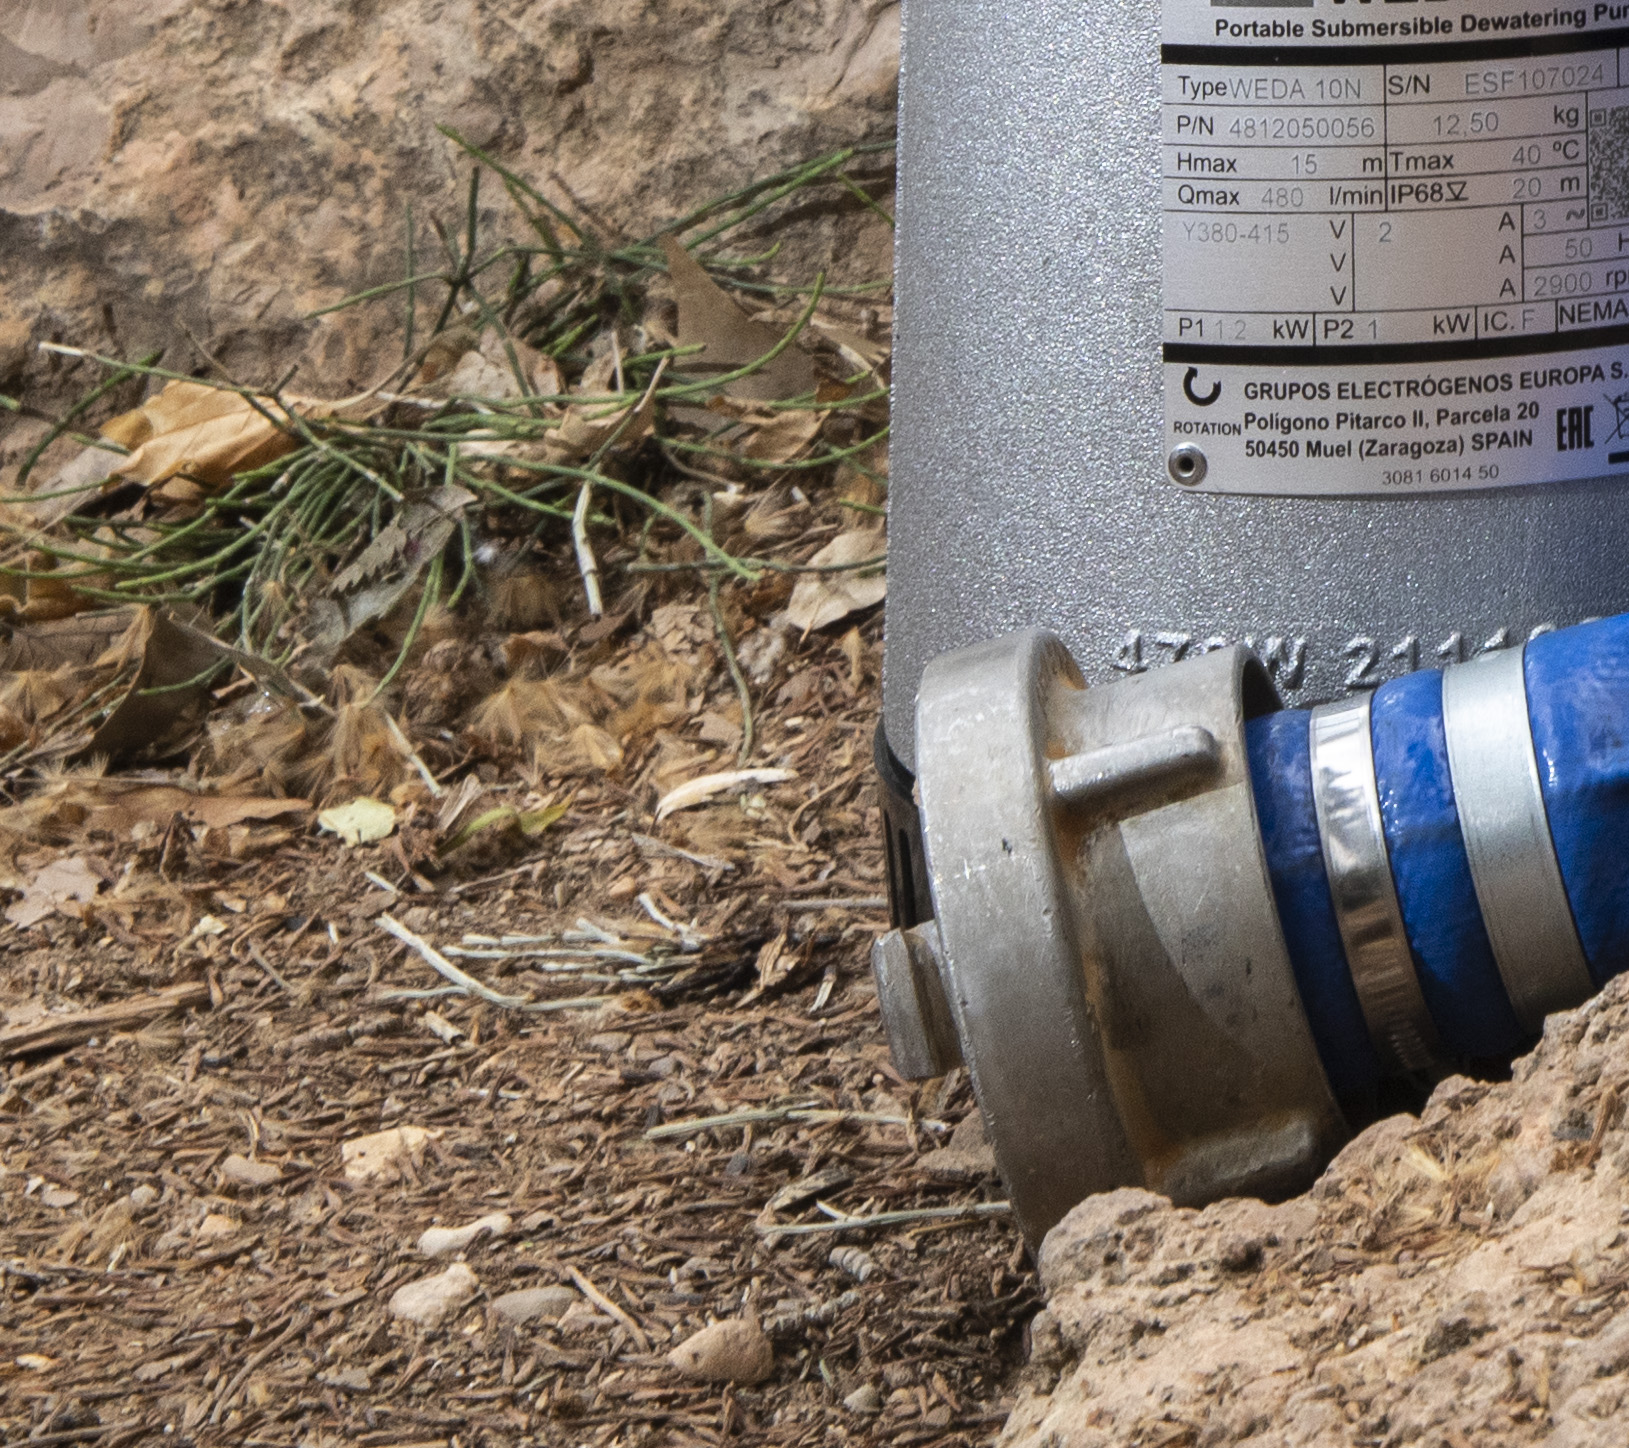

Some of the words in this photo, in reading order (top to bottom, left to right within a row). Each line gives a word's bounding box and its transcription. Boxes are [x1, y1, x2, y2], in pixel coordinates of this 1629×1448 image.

[1215, 18, 1304, 38] Portable
[1311, 15, 1453, 38] Submersible
[1461, 9, 1587, 33] Dewatering
[1178, 75, 1228, 101] Type
[1229, 78, 1306, 100] WEDA
[1316, 78, 1362, 99] 10N
[1388, 73, 1431, 96] S/N
[1465, 64, 1604, 95] ESF107024
[1177, 115, 1214, 136] P/N
[1229, 117, 1376, 139] 4812050056
[1554, 105, 1580, 128] kg
[1177, 152, 1238, 173] Hmax
[1291, 154, 1318, 175] 15
[1362, 157, 1383, 173] m
[1389, 151, 1454, 172] Tmax
[1512, 144, 1541, 165] 40
[1178, 184, 1241, 205] Qmax
[1261, 187, 1304, 206] 480
[1329, 185, 1383, 206] l/min
[1513, 177, 1542, 199] 20
[1560, 176, 1581, 192] m
[1378, 221, 1393, 243] 2
[1498, 211, 1516, 231] A
[1533, 209, 1547, 229] 3
[1183, 221, 1290, 244] Y380-415
[1329, 220, 1346, 240] V
[1499, 244, 1516, 265] A
[1565, 238, 1593, 259] 50
[1330, 253, 1346, 272] V
[1330, 286, 1347, 306] V
[1500, 278, 1516, 298] A
[1534, 272, 1593, 297] 2900
[1522, 309, 1535, 330] F
[1559, 298, 1629, 325] NEMA
[1179, 317, 1204, 337] P1
[1273, 319, 1309, 340] kW
[1324, 319, 1354, 340] P2
[1368, 319, 1378, 340] 1
[1433, 313, 1471, 335] kW
[1244, 382, 1331, 401] GRUPOS
[1337, 373, 1513, 400] ELECTRÓGENOS
[1519, 364, 1606, 390] EUROPA
[1173, 421, 1242, 436] ROTATION
[1244, 412, 1330, 434] Polígono
[1336, 410, 1406, 430] Pitarco
[1412, 409, 1430, 431] II,
[1436, 403, 1510, 426] Parcela
[1517, 401, 1540, 420] 20
[1556, 405, 1595, 452] EAC
[1245, 440, 1300, 458] 50450
[1306, 439, 1351, 458] Muel
[1358, 433, 1465, 462] (Zaragoza)
[1471, 429, 1533, 452] SPAIN
[1382, 468, 1423, 486] 3081
[1429, 466, 1472, 484] 6014
[1478, 464, 1500, 481] 50
